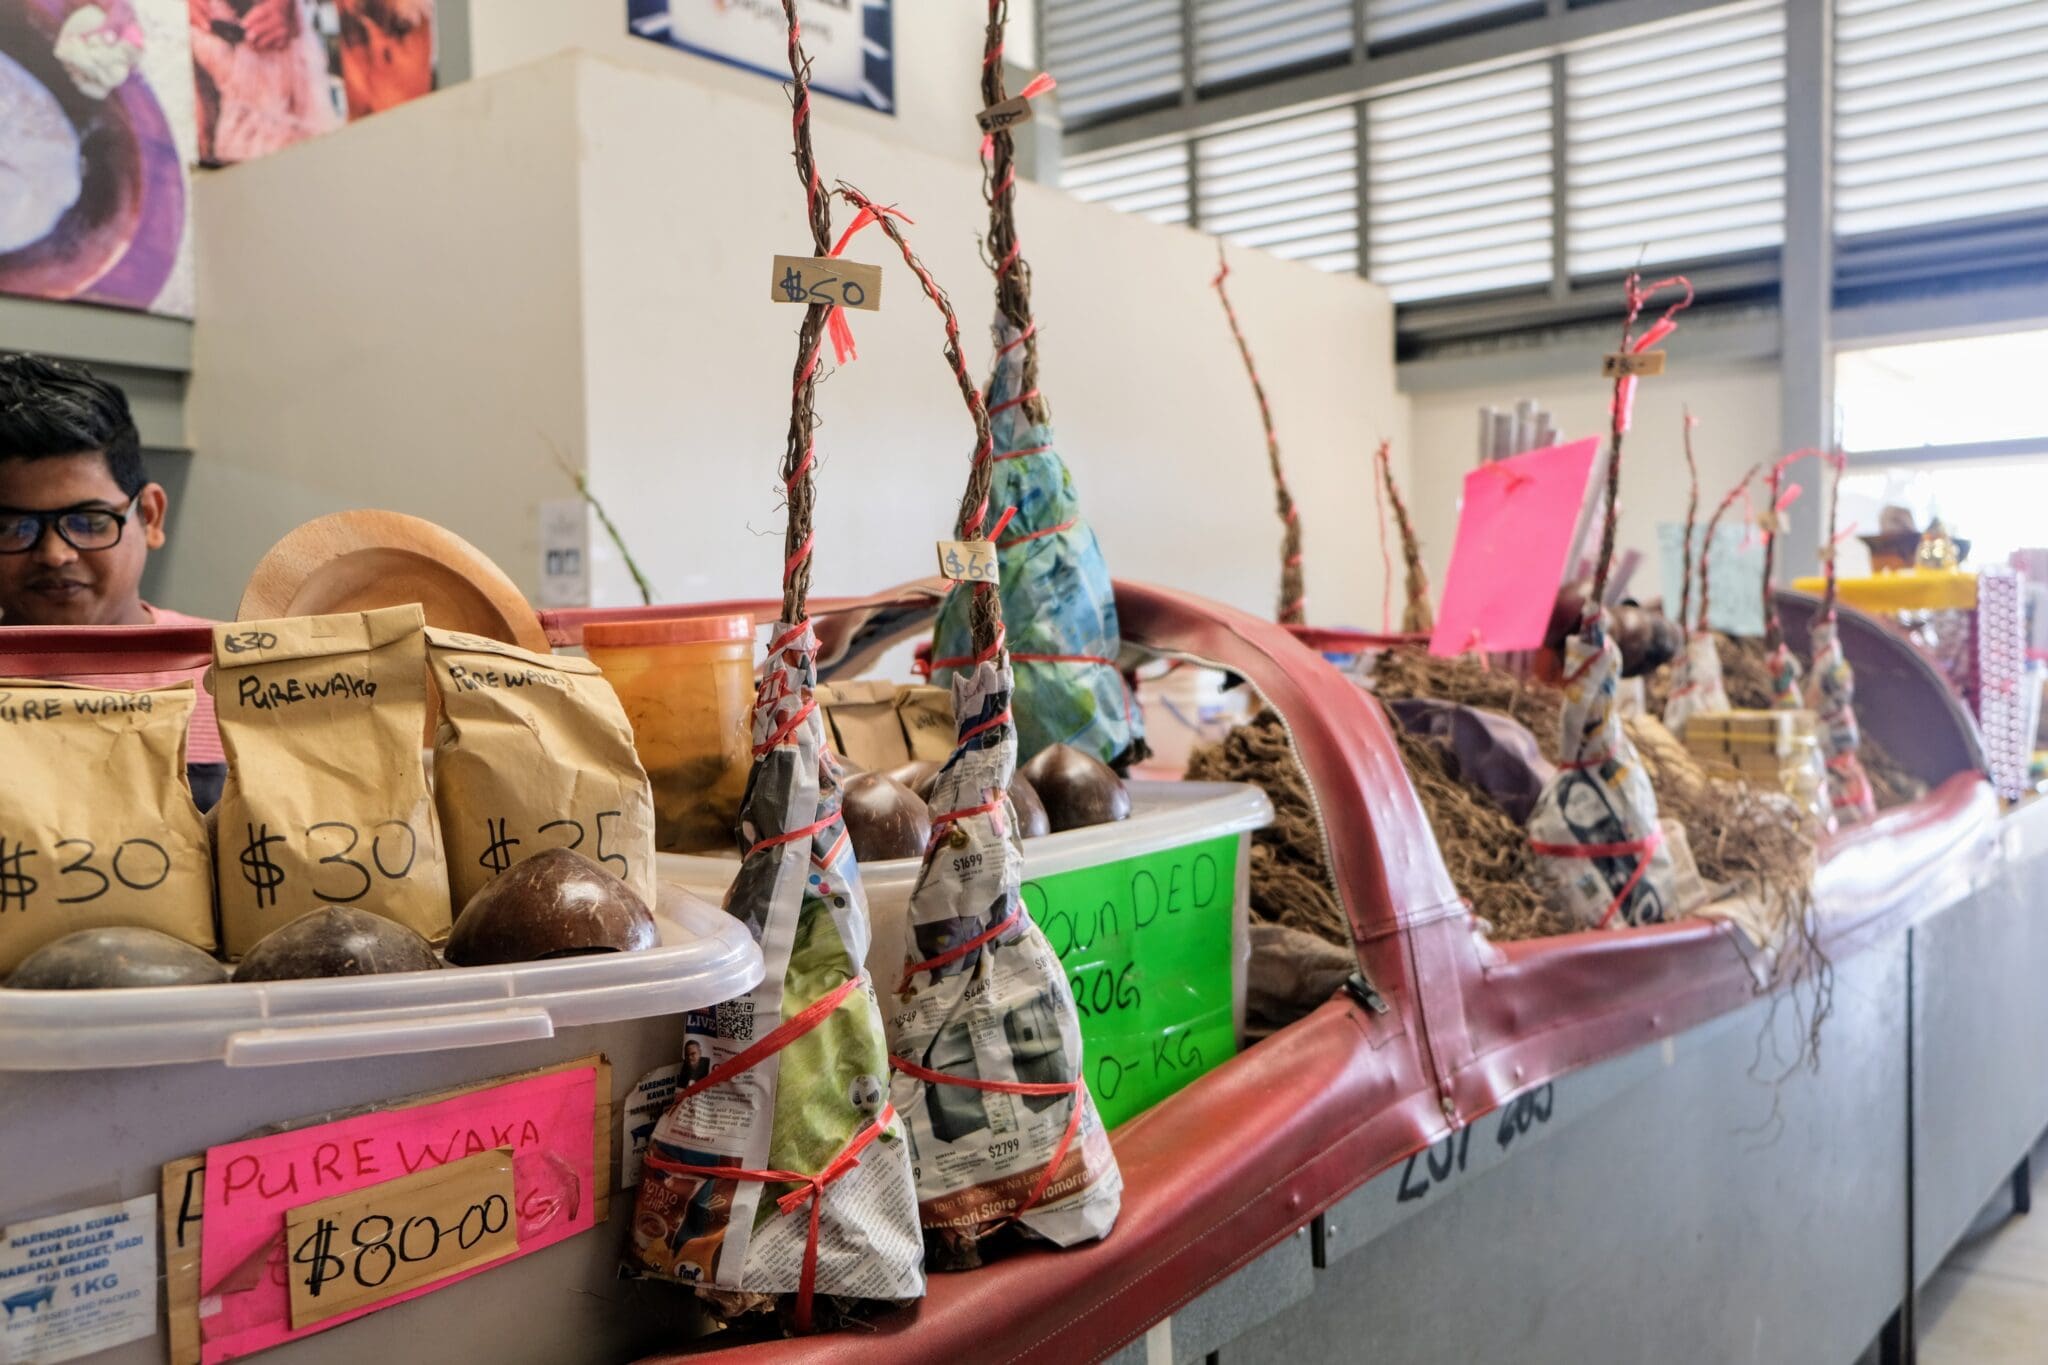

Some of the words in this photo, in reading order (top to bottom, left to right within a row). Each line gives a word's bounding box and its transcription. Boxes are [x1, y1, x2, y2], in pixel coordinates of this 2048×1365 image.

[780, 266, 865, 306] $50
[73, 694, 153, 715] WAKA
[0, 837, 171, 913] $30
[239, 820, 417, 909] $30
[953, 853, 983, 871] $1699
[1070, 960, 1142, 1017] ROG
[687, 1014, 718, 1034] LIVE
[222, 1138, 382, 1206] PURE
[396, 1119, 540, 1175] WAKA
[988, 1138, 1020, 1160] $2799
[643, 1178, 679, 1206] POTATO
[933, 1199, 956, 1214] Join
[981, 1197, 1017, 1218] Store
[10, 1224, 82, 1249] NARENDRA
[85, 1212, 130, 1231] KUMAR
[28, 1242, 63, 1259] KAVA
[66, 1229, 115, 1249] DEALER
[0, 1258, 54, 1280] NAMAKA
[114, 1235, 144, 1251] NADI
[293, 1194, 509, 1298] $80-00
[36, 1270, 61, 1284] FIJI
[64, 1258, 110, 1278] ISLAND
